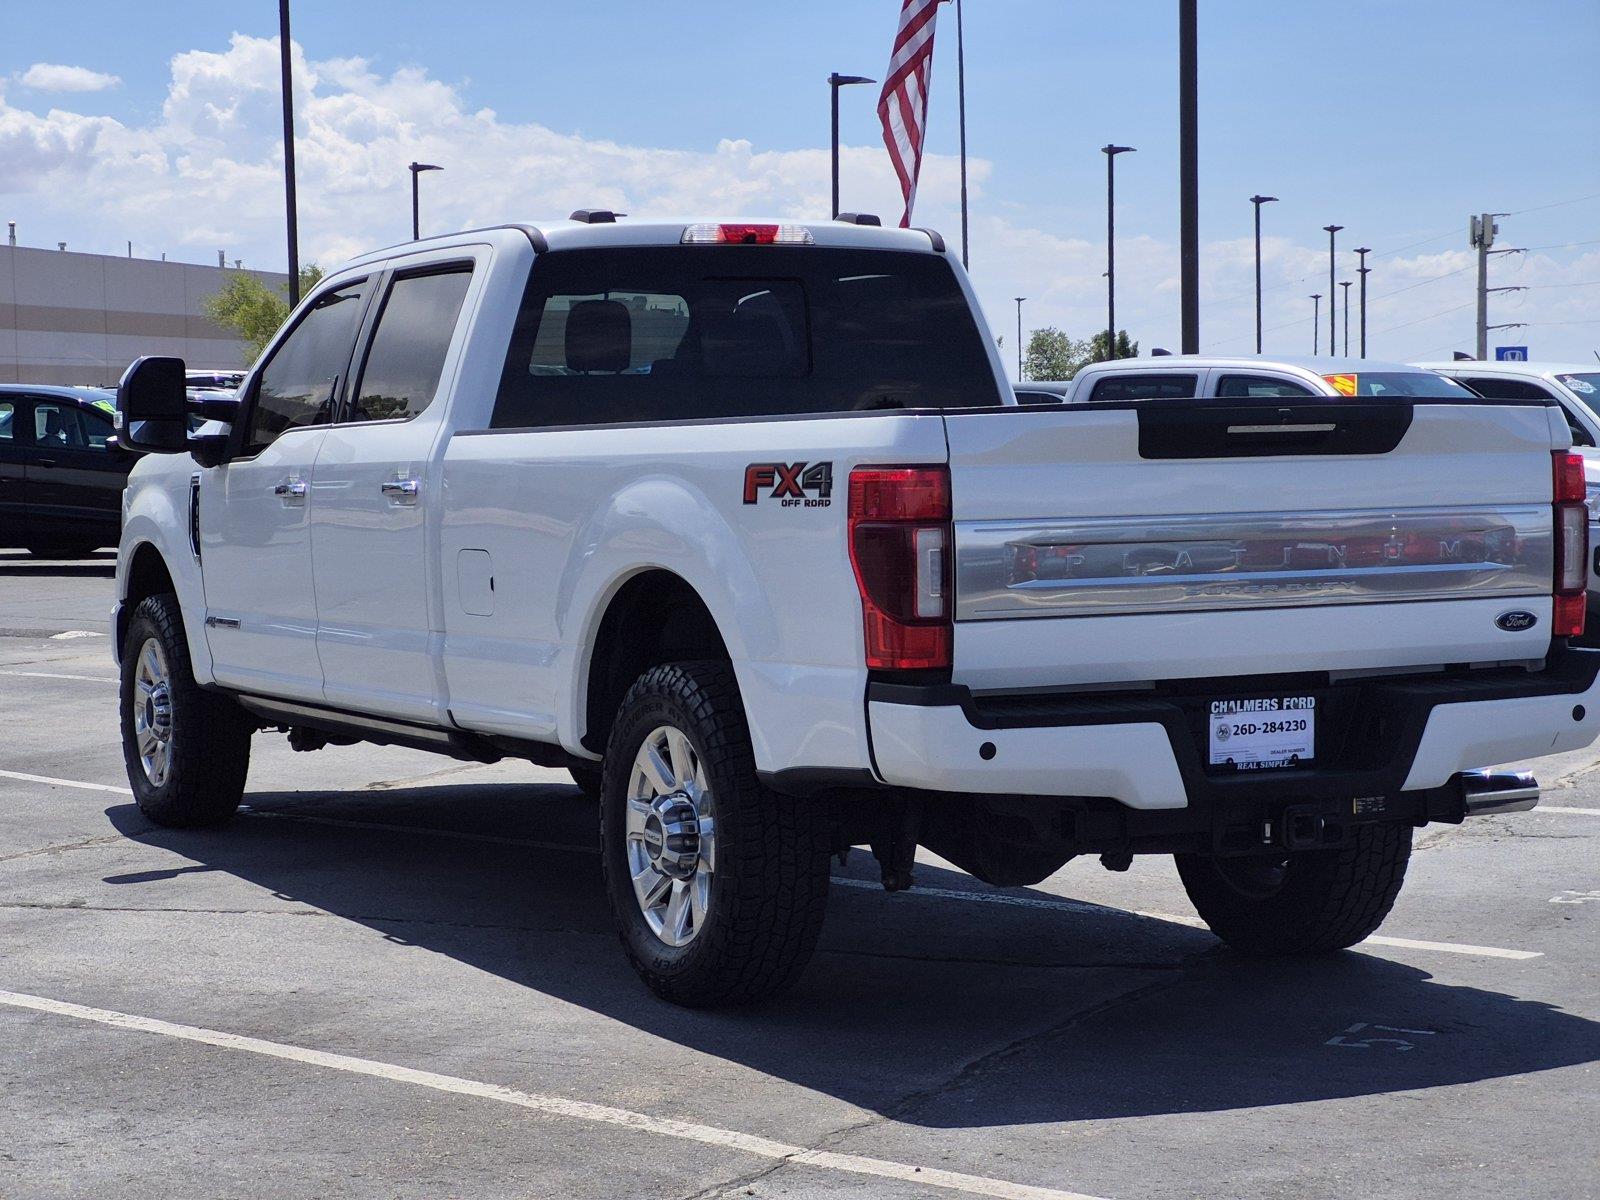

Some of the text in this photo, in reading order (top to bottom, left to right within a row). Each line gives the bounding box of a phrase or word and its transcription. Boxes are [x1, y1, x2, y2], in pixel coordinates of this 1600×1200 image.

[743, 461, 833, 505] FX4
[781, 499, 831, 508] OFF ROAD
[1065, 540, 1461, 572] PLATINUM
[1506, 613, 1530, 627] Ford
[1211, 697, 1316, 714] CHALMERS FORD
[1233, 719, 1307, 736] 26D-284230
[1237, 759, 1289, 770] REAL SIMPLE
